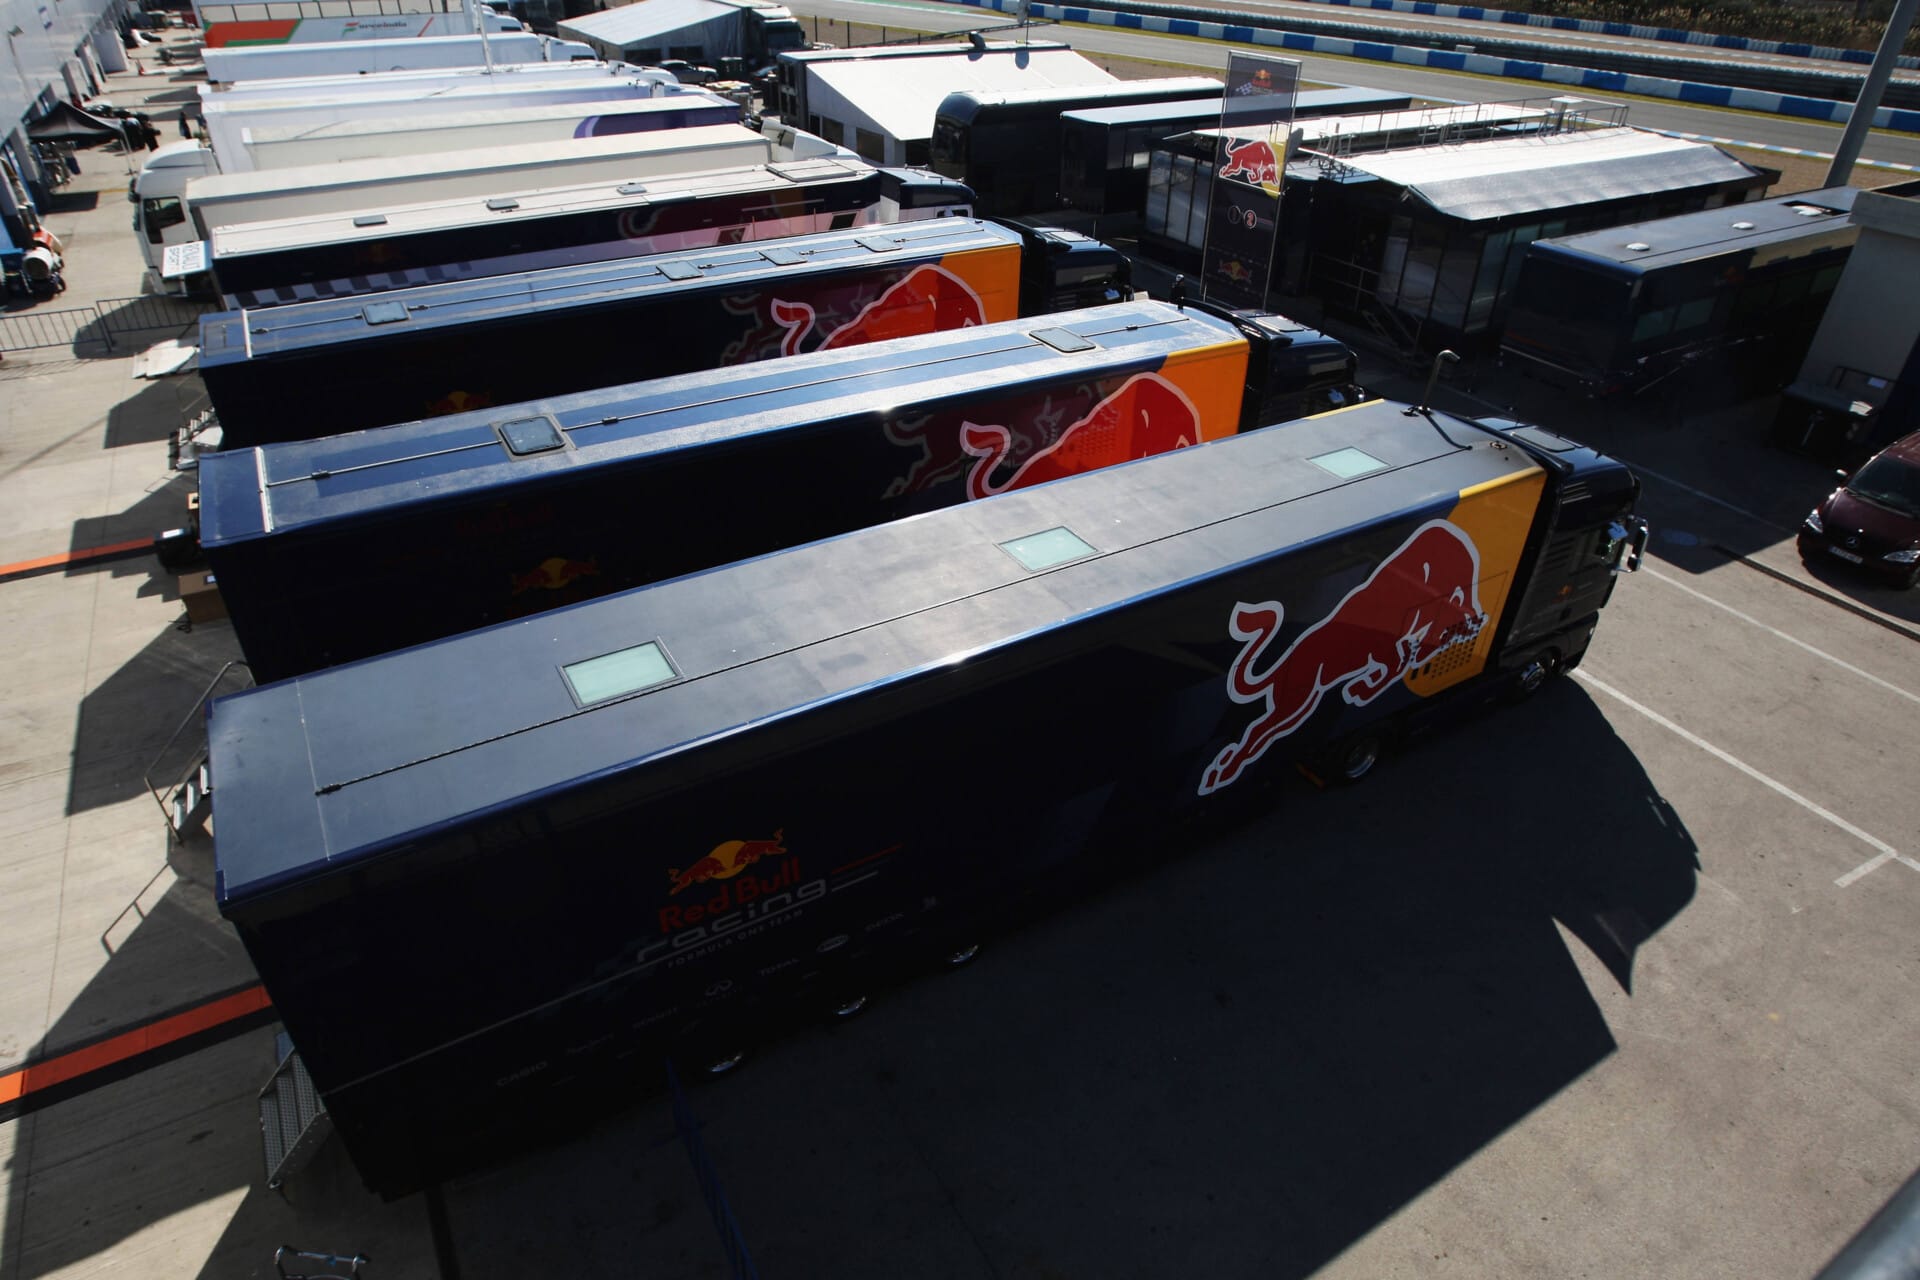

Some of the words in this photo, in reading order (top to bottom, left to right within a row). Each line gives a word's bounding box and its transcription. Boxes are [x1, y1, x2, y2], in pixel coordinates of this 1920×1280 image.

[636, 878, 827, 963] racing
[657, 883, 731, 935] Red
[735, 855, 801, 905] Bull
[667, 934, 735, 969] FORMULA
[737, 924, 765, 943] ONE
[768, 908, 804, 932] TEAM
[495, 1059, 548, 1088] CASIO
